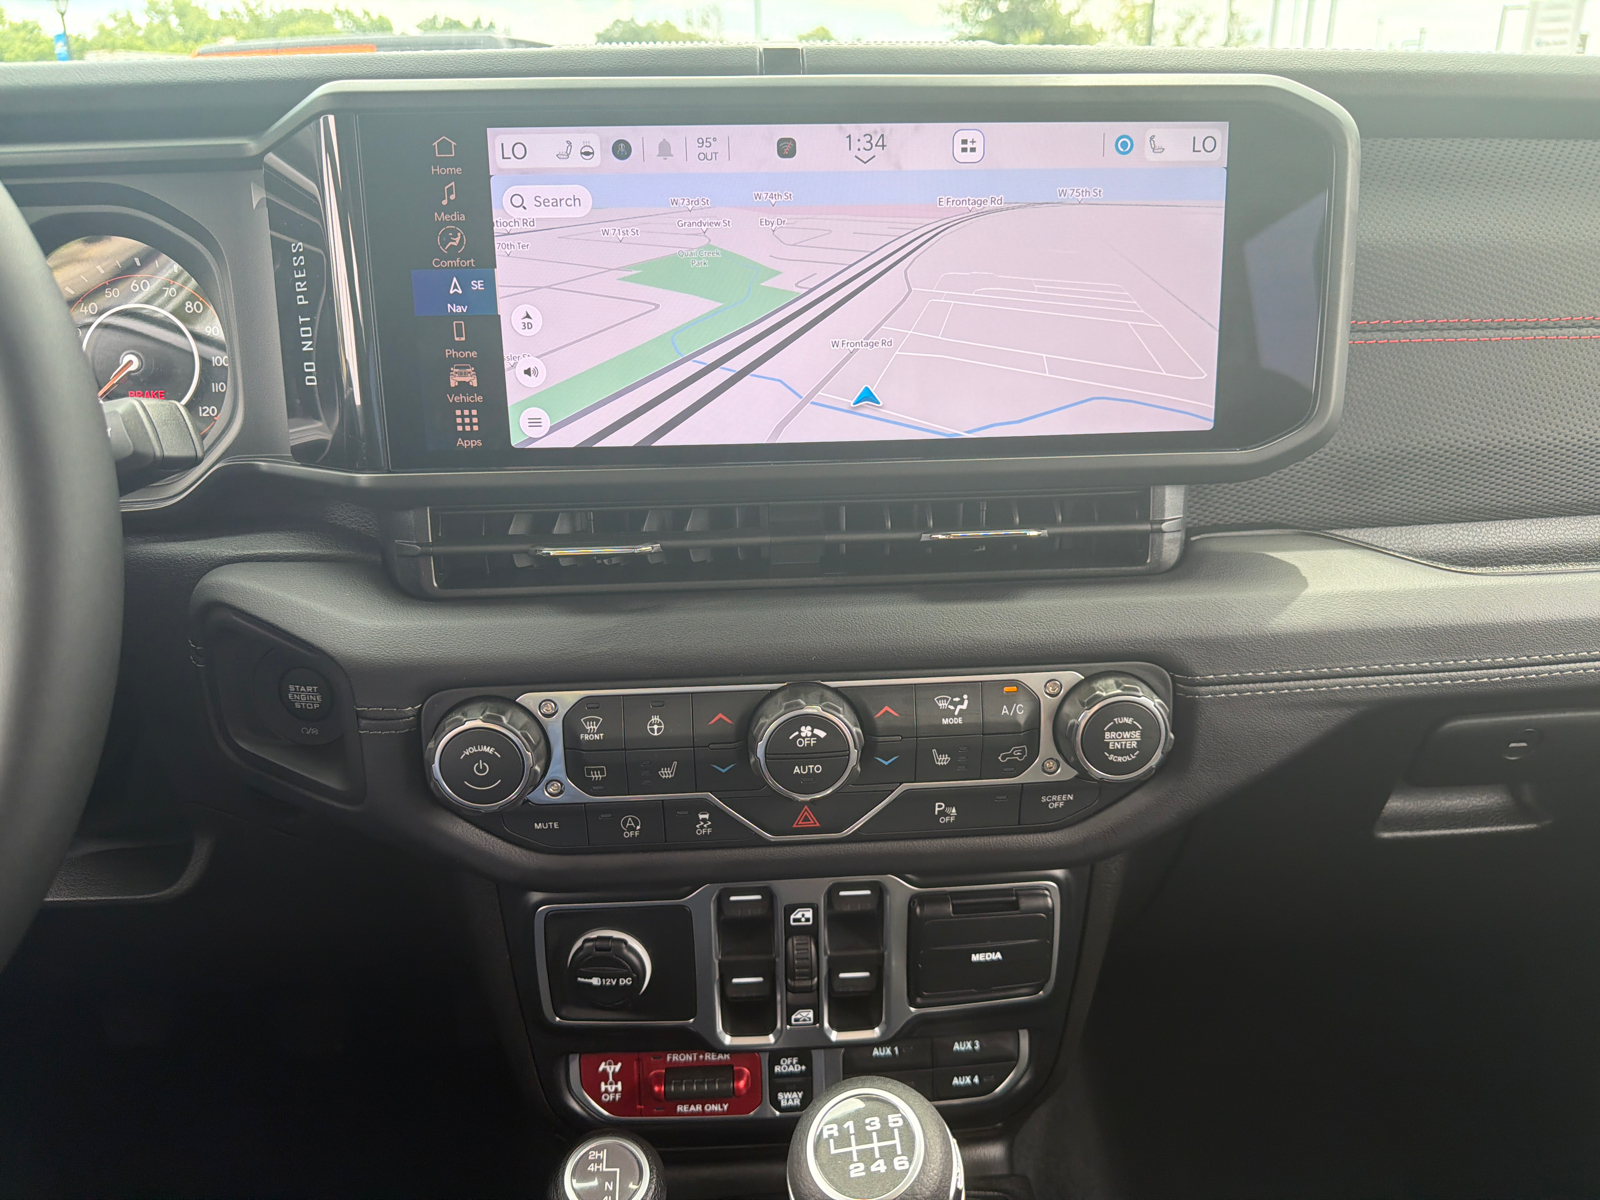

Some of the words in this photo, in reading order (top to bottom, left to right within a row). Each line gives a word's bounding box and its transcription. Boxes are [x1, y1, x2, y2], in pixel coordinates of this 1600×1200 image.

[845, 133, 887, 152] 1:34
[1192, 135, 1217, 153] LO
[500, 142, 527, 160] LO
[697, 152, 719, 161] OUT
[431, 165, 462, 175] Home
[753, 192, 763, 200] W
[764, 192, 782, 200] 74th
[784, 192, 792, 200] St
[1058, 188, 1068, 198] W
[1069, 188, 1091, 198] 75th
[1093, 188, 1102, 198] St
[533, 194, 582, 209] Search
[670, 198, 680, 206] W
[681, 197, 699, 206] 73rd
[702, 197, 710, 206] St
[938, 197, 944, 206] E
[946, 196, 988, 208] Frontage
[990, 196, 1003, 206] Rd
[434, 211, 466, 222] Media
[494, 218, 520, 228] tioch
[522, 218, 535, 228] Rd
[677, 219, 720, 228] Grandview
[723, 219, 731, 227] St
[760, 218, 774, 227] Eby
[777, 218, 787, 226] Dr
[601, 228, 611, 236] W
[612, 228, 629, 236] 71st
[631, 228, 639, 236] St
[496, 242, 515, 250] 70th
[517, 242, 530, 250] Ter
[678, 249, 698, 258] Quail
[699, 249, 721, 257] Creek
[432, 257, 475, 268] Comfort
[691, 259, 708, 267] Park
[291, 241, 308, 305] PRESS
[130, 279, 150, 292] 60
[471, 280, 485, 290] SE
[105, 287, 120, 298] 50
[162, 287, 177, 298] 70
[79, 302, 98, 315] 40
[185, 301, 203, 314] 80
[447, 304, 468, 313] Nav
[204, 325, 220, 336] 90
[521, 321, 533, 330] 3D
[298, 315, 314, 352] NOT
[831, 339, 840, 348] W
[841, 339, 879, 350] Frontage
[881, 338, 893, 348] Rd
[445, 349, 478, 359] Phone
[212, 355, 229, 367] 100
[302, 361, 318, 386] DO
[212, 382, 226, 393] 110
[128, 390, 165, 400] BRAKE
[447, 393, 483, 403] Vehicle
[199, 405, 218, 417] 120
[456, 437, 483, 448] Apps
[288, 684, 319, 692] START
[288, 693, 323, 701] ENGINE
[294, 702, 320, 710] STOP
[1001, 703, 1024, 716] A/C
[942, 717, 963, 725] MODE
[1113, 717, 1134, 725] TUNE
[580, 733, 604, 741] FRONT
[1104, 730, 1141, 739] BROWSE
[796, 737, 817, 747] OFF
[1109, 741, 1138, 750] ENTER
[462, 744, 496, 756] VOLUME
[1107, 753, 1136, 762] SCROLL
[793, 764, 822, 775] AUTO
[1041, 793, 1074, 802] SCREEN
[1048, 801, 1065, 809] OFF
[939, 816, 955, 824] OFF
[534, 821, 559, 830] MUTE
[623, 830, 640, 838] OFF
[695, 828, 712, 836] OFF
[971, 951, 1002, 962] MEDIA
[601, 978, 617, 986] 12V
[619, 977, 633, 985] DC
[952, 1041, 973, 1051] AUX
[974, 1040, 980, 1050] 3
[872, 1046, 892, 1057] AUX
[894, 1046, 899, 1056] 1
[780, 1057, 798, 1065] OFF
[774, 1064, 806, 1073] ROAD+
[952, 1075, 972, 1086] AUX
[973, 1074, 979, 1085] 4
[601, 1093, 622, 1101] OFF
[777, 1091, 803, 1100] SWAY
[676, 1103, 702, 1112] REAR
[704, 1103, 729, 1112] ONLY
[780, 1098, 800, 1107] BAR
[822, 1124, 840, 1139] R
[843, 1121, 855, 1134] 1
[865, 1116, 881, 1131] 3
[887, 1114, 904, 1128] 5
[588, 1150, 603, 1160] 2H
[587, 1162, 602, 1172] 4H
[849, 1162, 866, 1178] 2
[870, 1158, 887, 1173] 4
[893, 1155, 910, 1171] 6
[604, 1181, 613, 1191] N
